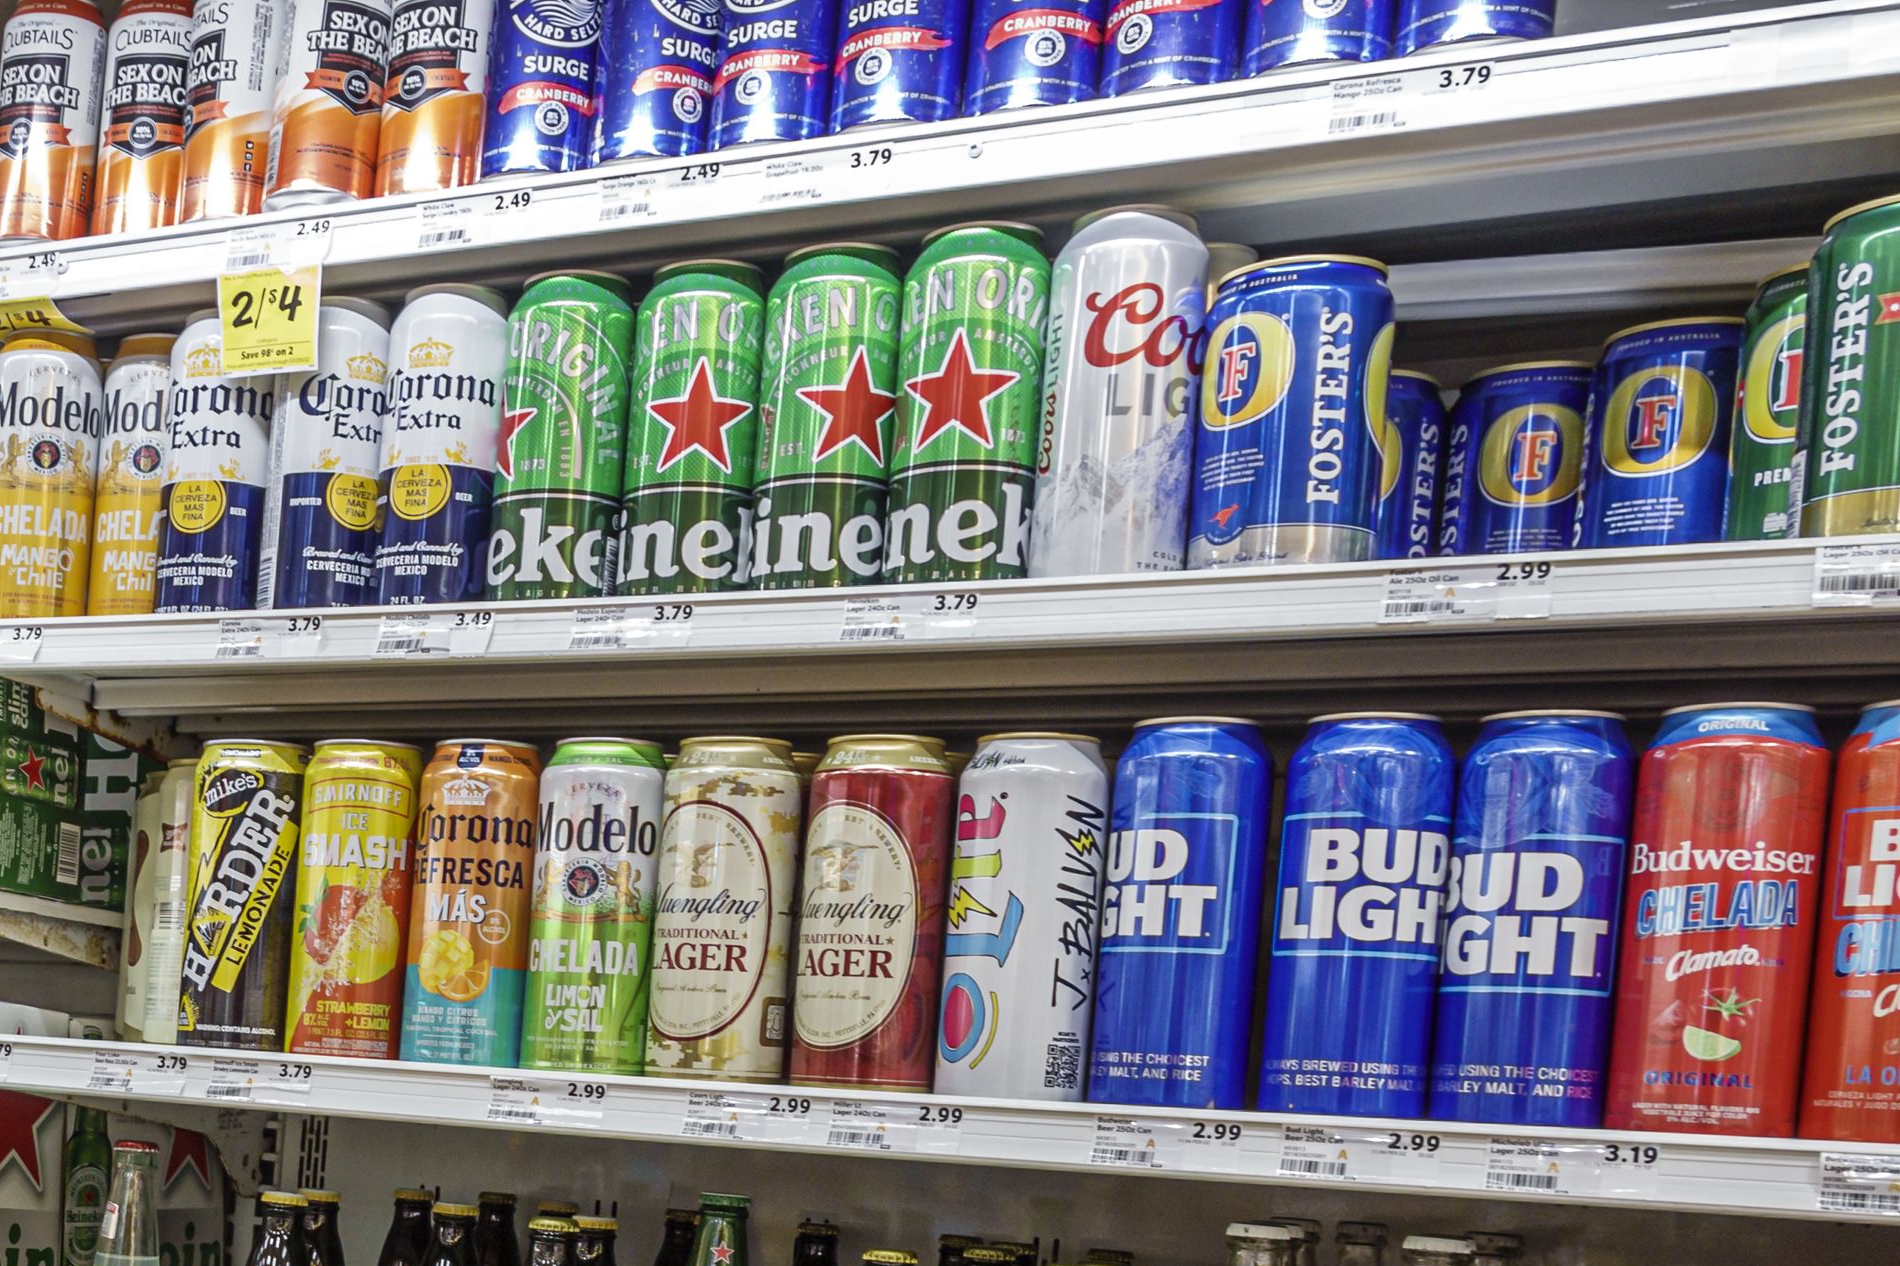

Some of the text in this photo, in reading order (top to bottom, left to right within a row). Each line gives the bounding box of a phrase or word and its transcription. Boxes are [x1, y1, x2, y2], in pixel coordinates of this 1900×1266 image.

[727, 19, 798, 48] SURGE
[1003, 12, 1092, 35] CRANBERRY
[418, 26, 477, 53] BEACH
[522, 54, 590, 81] SURGE
[1439, 65, 1492, 89] 3.79
[17, 85, 79, 110] BEACH
[515, 87, 592, 111] CRANBERRY
[850, 148, 892, 170] 3.79
[680, 162, 721, 181] 2.49
[495, 192, 531, 210] 2.49
[28, 252, 56, 271] 2.49
[1819, 262, 1874, 477] FOSTER'S
[1306, 305, 1354, 505] FOSTER'S
[393, 405, 463, 434] Extra
[171, 420, 242, 450] Extra
[455, 492, 473, 503] BEER
[1496, 561, 1551, 582] 2.99
[653, 605, 694, 622] 3.79
[934, 593, 978, 611] 3.79
[455, 612, 492, 628] 3.49
[12, 627, 43, 642] 3.79
[204, 773, 259, 811] mike's
[314, 784, 403, 808] SMIRNOFF
[339, 812, 369, 831] ICE
[420, 807, 535, 851] Corona
[538, 810, 657, 854] Modelo
[303, 828, 408, 872] SMASH
[1306, 828, 1449, 887] BUD
[1631, 840, 1816, 877] Budweiser
[414, 858, 525, 889] REFRESCA
[225, 842, 295, 968] LEMONADE
[428, 892, 487, 923] MÁS
[1636, 879, 1799, 938] CHELADA
[529, 938, 639, 975] CHELADA
[1665, 944, 1761, 983] Clamato
[316, 1001, 392, 1017] STRAWBERRY
[156, 1054, 188, 1072] 3.79
[1458, 1063, 1501, 1079] USING
[1503, 1065, 1534, 1079] THE
[567, 1082, 606, 1100] 2.99
[1644, 1070, 1755, 1090] ORIGINAL
[1191, 1121, 1242, 1142] 2.99
[1604, 1144, 1658, 1165] 3.19
